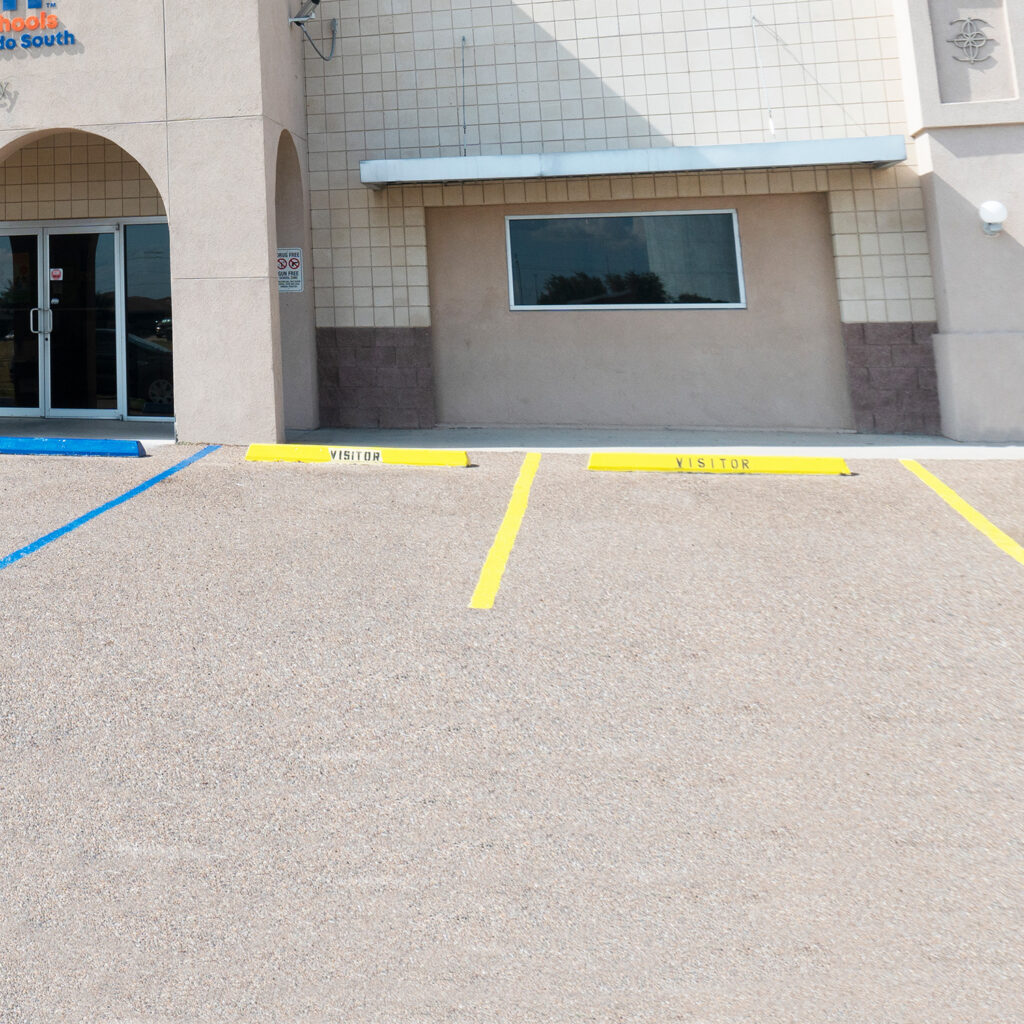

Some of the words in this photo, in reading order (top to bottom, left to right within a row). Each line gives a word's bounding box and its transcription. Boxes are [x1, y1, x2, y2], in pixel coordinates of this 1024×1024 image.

[20, 30, 76, 49] South
[330, 450, 380, 462] VISITOR
[676, 457, 750, 470] VISITOR
